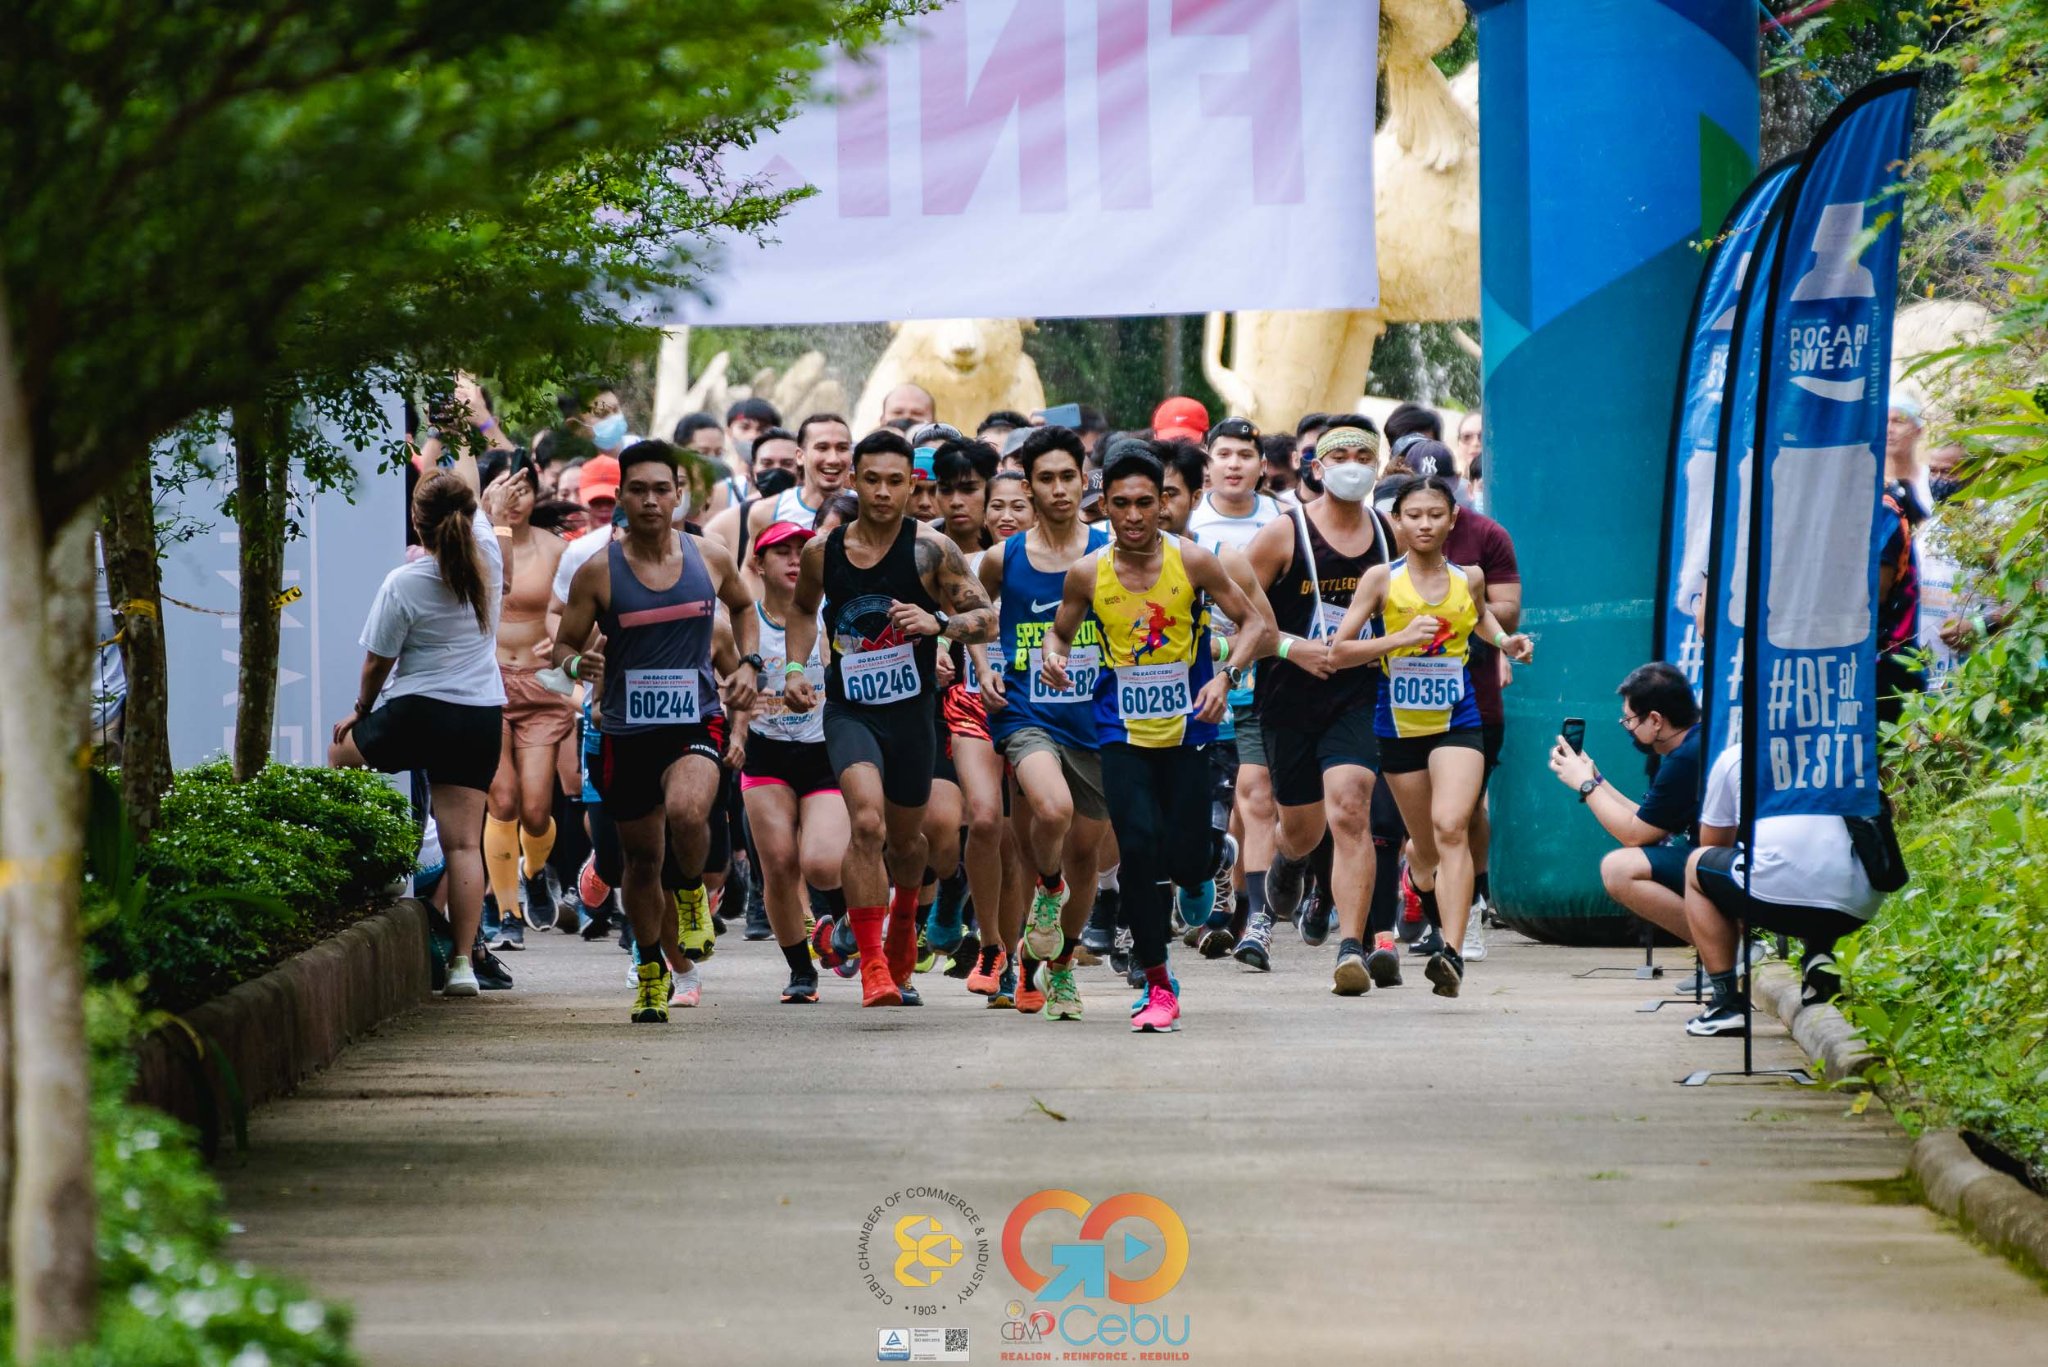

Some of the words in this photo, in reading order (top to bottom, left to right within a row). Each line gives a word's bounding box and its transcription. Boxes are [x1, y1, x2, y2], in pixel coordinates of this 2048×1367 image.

[1790, 324, 1869, 349] POCARI
[1789, 345, 1863, 371] SWEAT
[847, 664, 917, 702] 60246
[1122, 682, 1187, 715] 60283
[1394, 676, 1460, 705] 60356
[1768, 655, 1837, 730] #BE
[1839, 652, 1858, 699] at
[630, 691, 695, 719] 60244
[1770, 733, 1865, 791] BEST!
